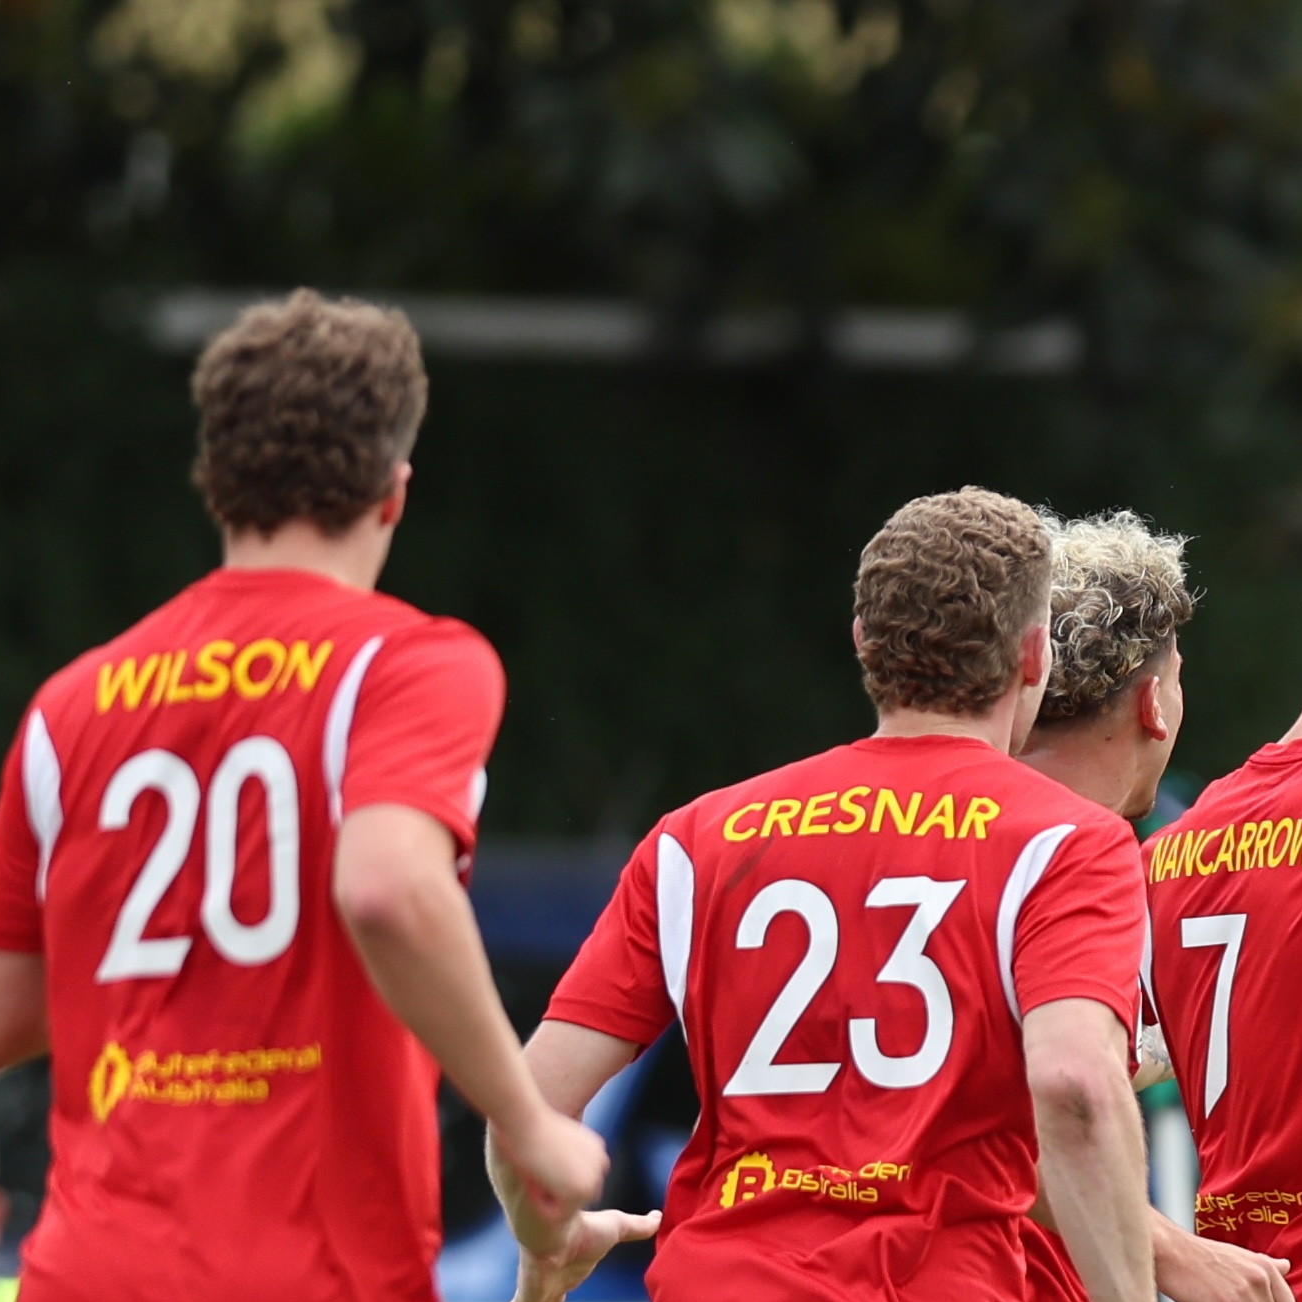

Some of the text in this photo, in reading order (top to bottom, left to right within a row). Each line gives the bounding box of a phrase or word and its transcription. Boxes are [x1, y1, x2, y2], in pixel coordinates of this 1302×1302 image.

[98, 637, 333, 714] WILSON
[95, 734, 300, 984] 20
[722, 785, 1001, 843] CRESNAR
[722, 875, 968, 1098] 23
[1180, 913, 1248, 1121] 7
